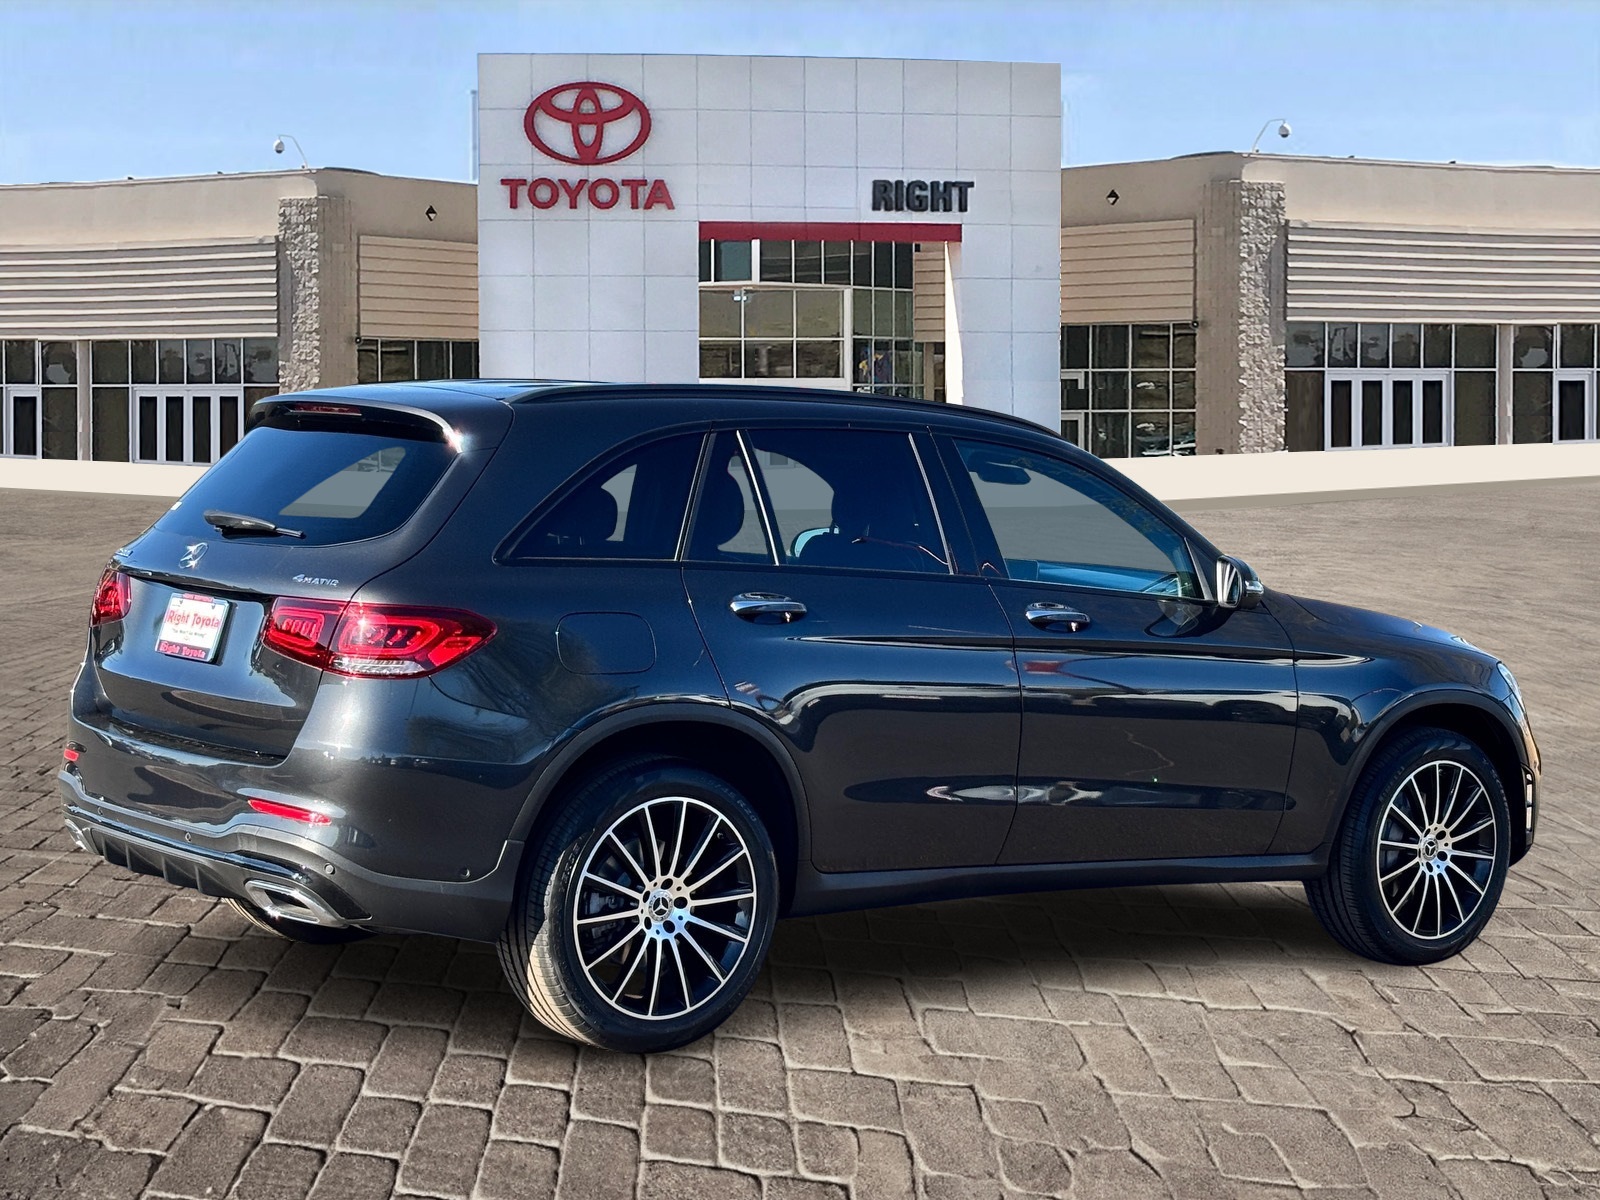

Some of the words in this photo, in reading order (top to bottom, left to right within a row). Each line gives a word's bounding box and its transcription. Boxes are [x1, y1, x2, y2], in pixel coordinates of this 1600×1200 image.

[500, 178, 676, 211] TOYOTA
[871, 179, 975, 213] RIGHT
[166, 609, 190, 626] Right
[191, 612, 222, 629] Toyota
[159, 640, 180, 654] Right
[182, 646, 206, 659] Toyota
